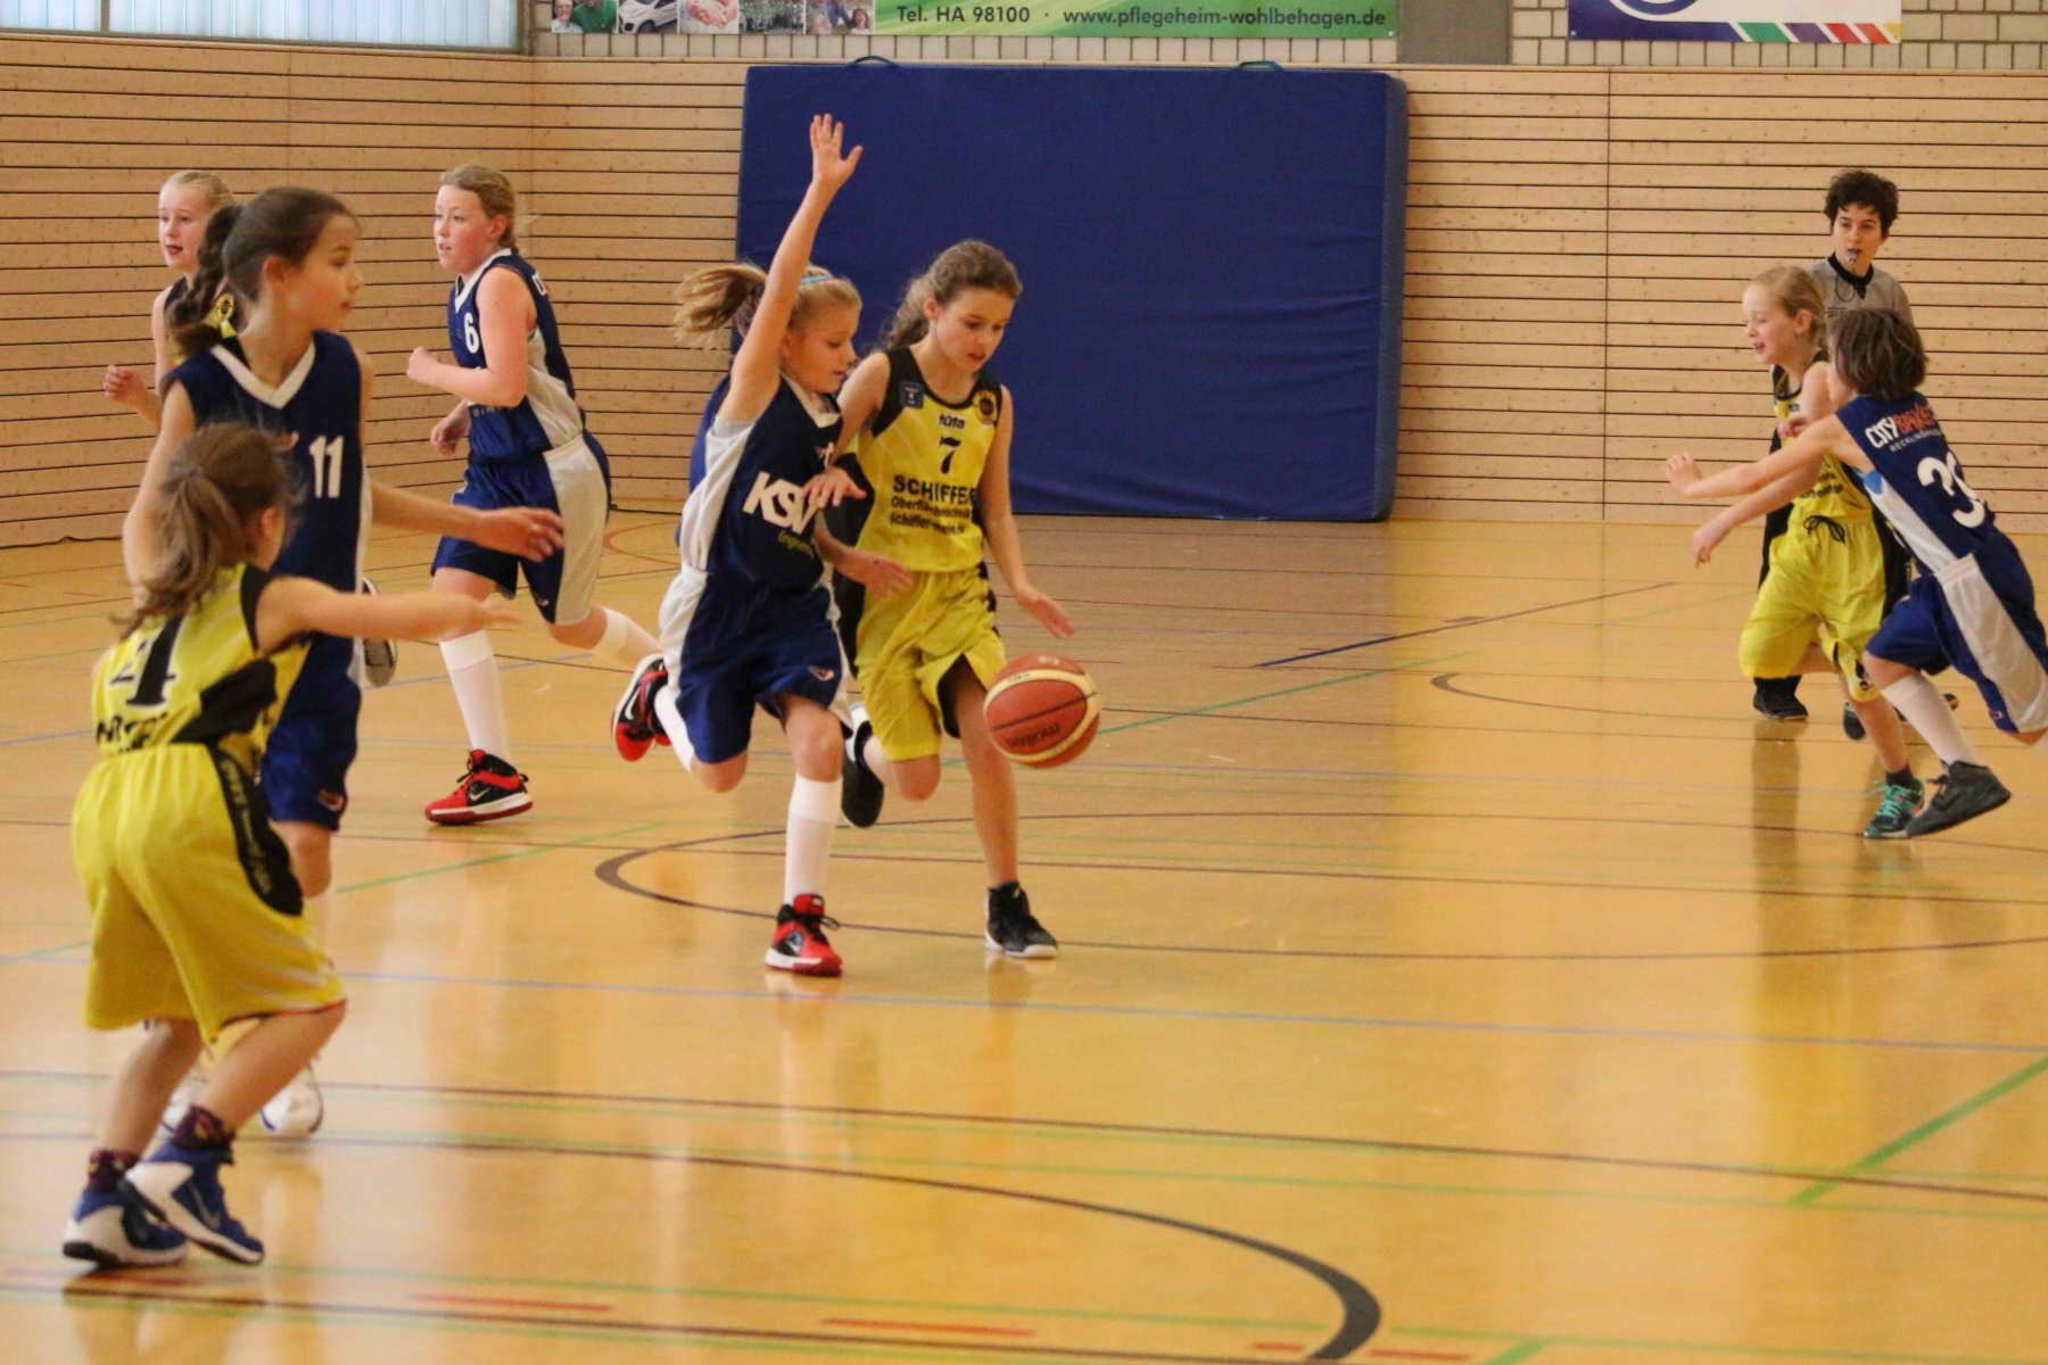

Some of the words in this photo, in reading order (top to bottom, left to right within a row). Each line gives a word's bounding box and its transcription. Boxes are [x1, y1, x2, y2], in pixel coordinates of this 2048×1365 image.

[897, 6, 927, 22] Tel.
[937, 6, 965, 22] HA
[973, 6, 1030, 22] 98100
[1063, 8, 1386, 29] www.pflegeheim-wohlbehagen.de
[464, 312, 480, 354] 6
[309, 435, 344, 498] 11
[939, 436, 962, 475] 7
[742, 470, 819, 534] KSV
